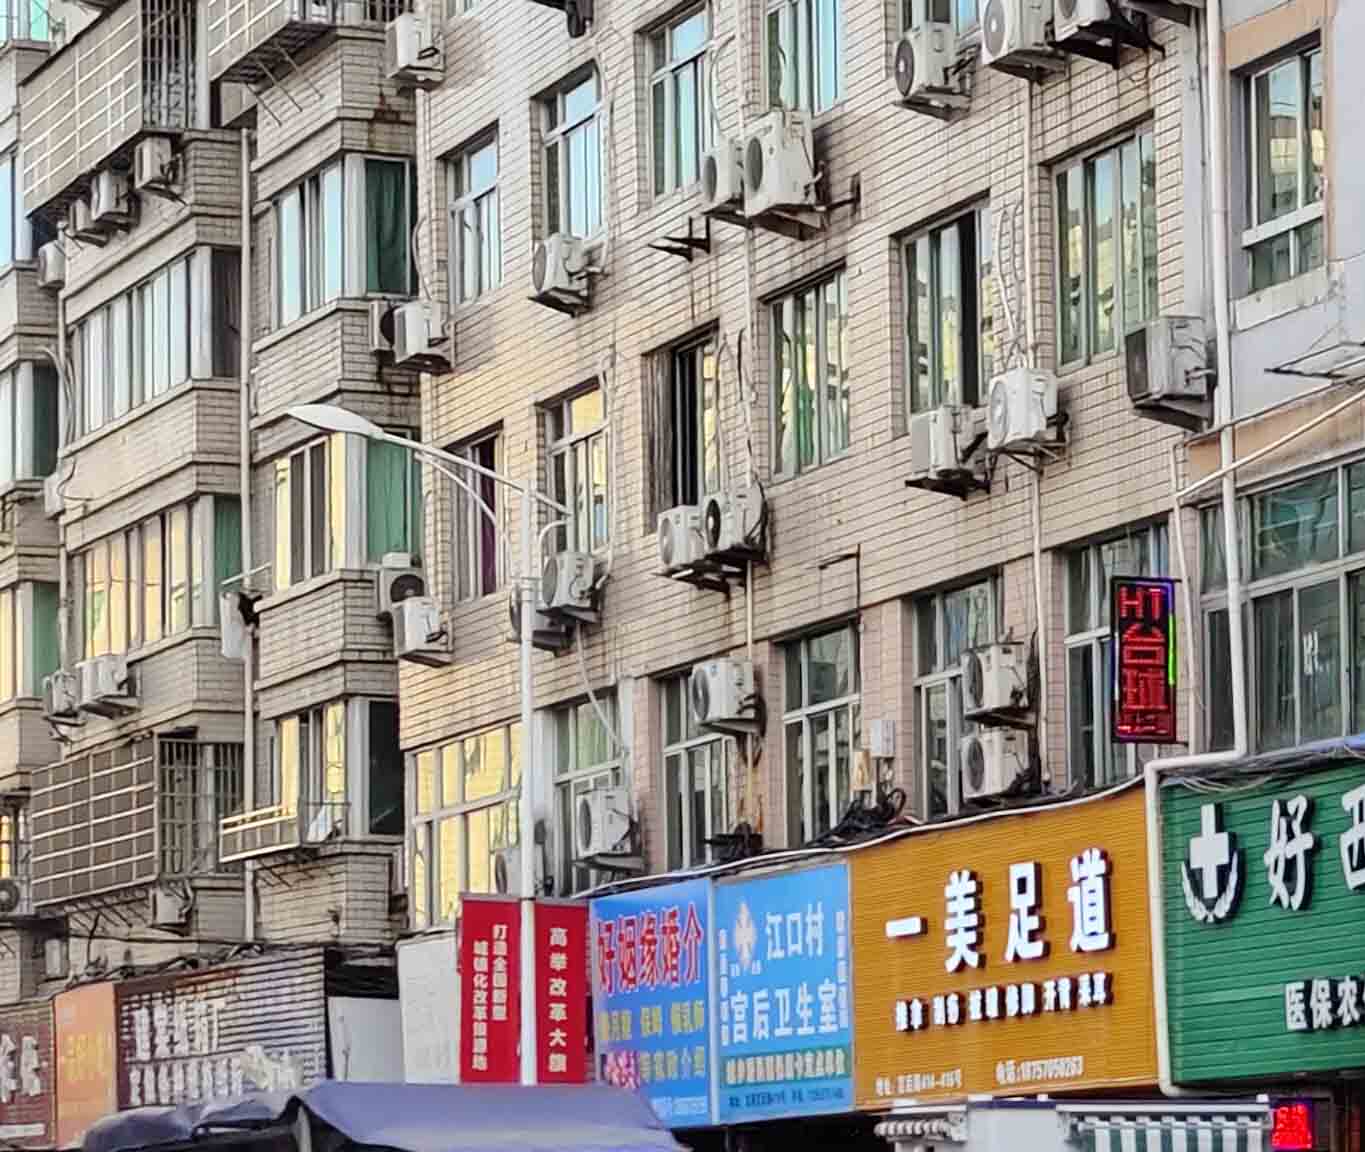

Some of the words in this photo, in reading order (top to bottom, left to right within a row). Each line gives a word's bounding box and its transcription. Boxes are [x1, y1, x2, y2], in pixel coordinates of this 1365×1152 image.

[765, 901, 824, 961] 江口村
[884, 847, 1111, 973] 一美足道
[730, 977, 839, 1046] 宫后卫生室
